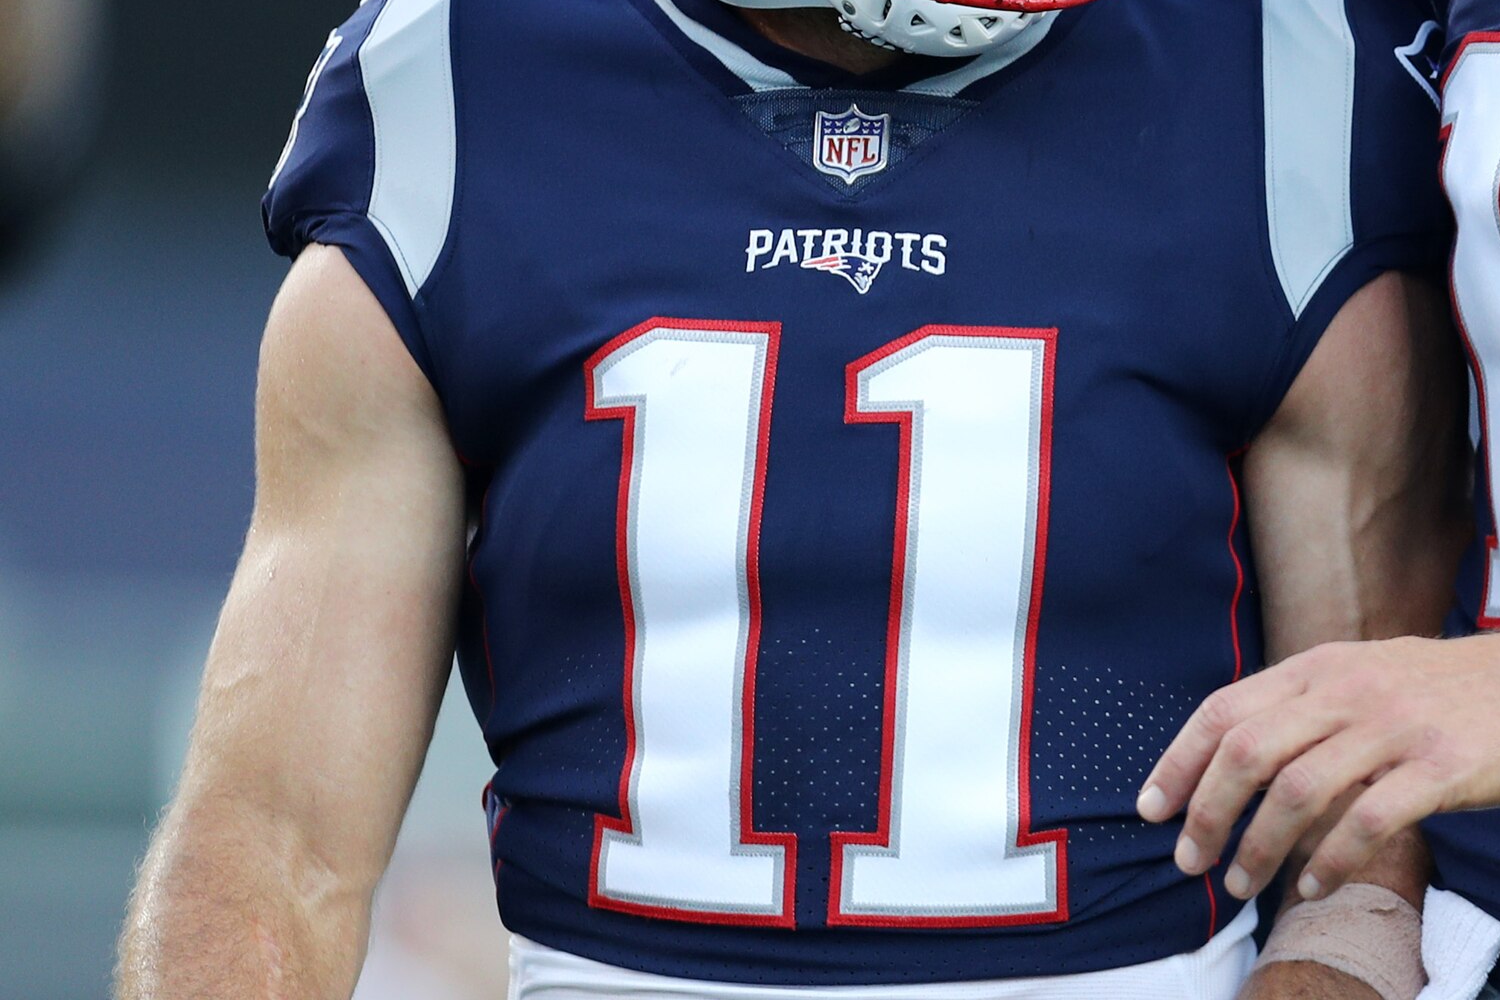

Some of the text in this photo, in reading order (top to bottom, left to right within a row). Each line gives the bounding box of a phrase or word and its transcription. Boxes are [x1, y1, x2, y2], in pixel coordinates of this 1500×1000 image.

[825, 137, 876, 168] NFL
[745, 228, 948, 276] PATRIOTS
[584, 315, 1070, 931] 11
